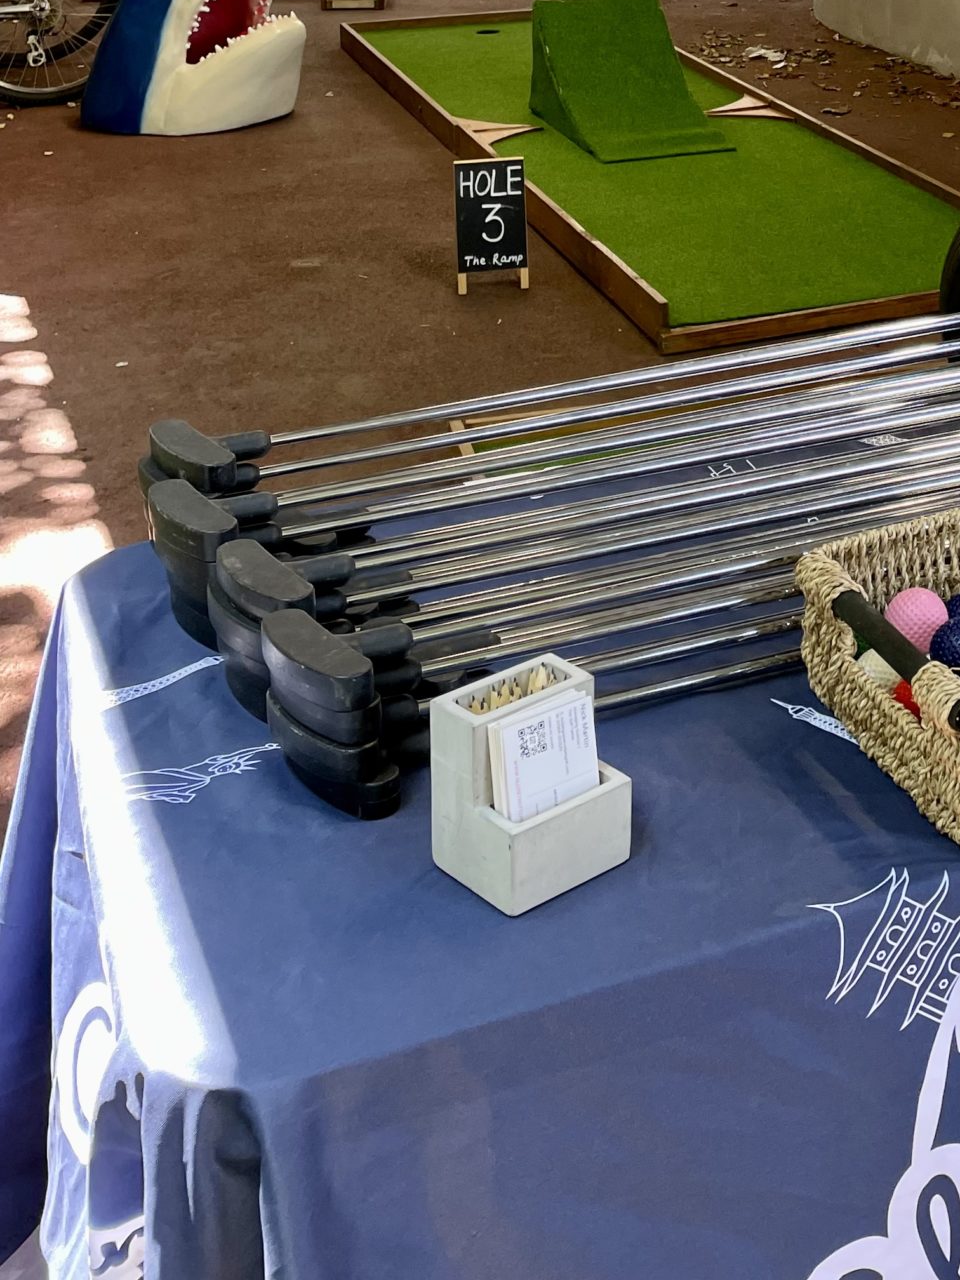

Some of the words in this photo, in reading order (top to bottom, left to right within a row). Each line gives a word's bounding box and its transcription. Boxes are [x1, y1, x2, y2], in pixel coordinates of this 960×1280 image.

[460, 166, 522, 198] HOLE
[481, 203, 505, 243] 3
[464, 255, 486, 267] The
[492, 253, 524, 266] Ramp
